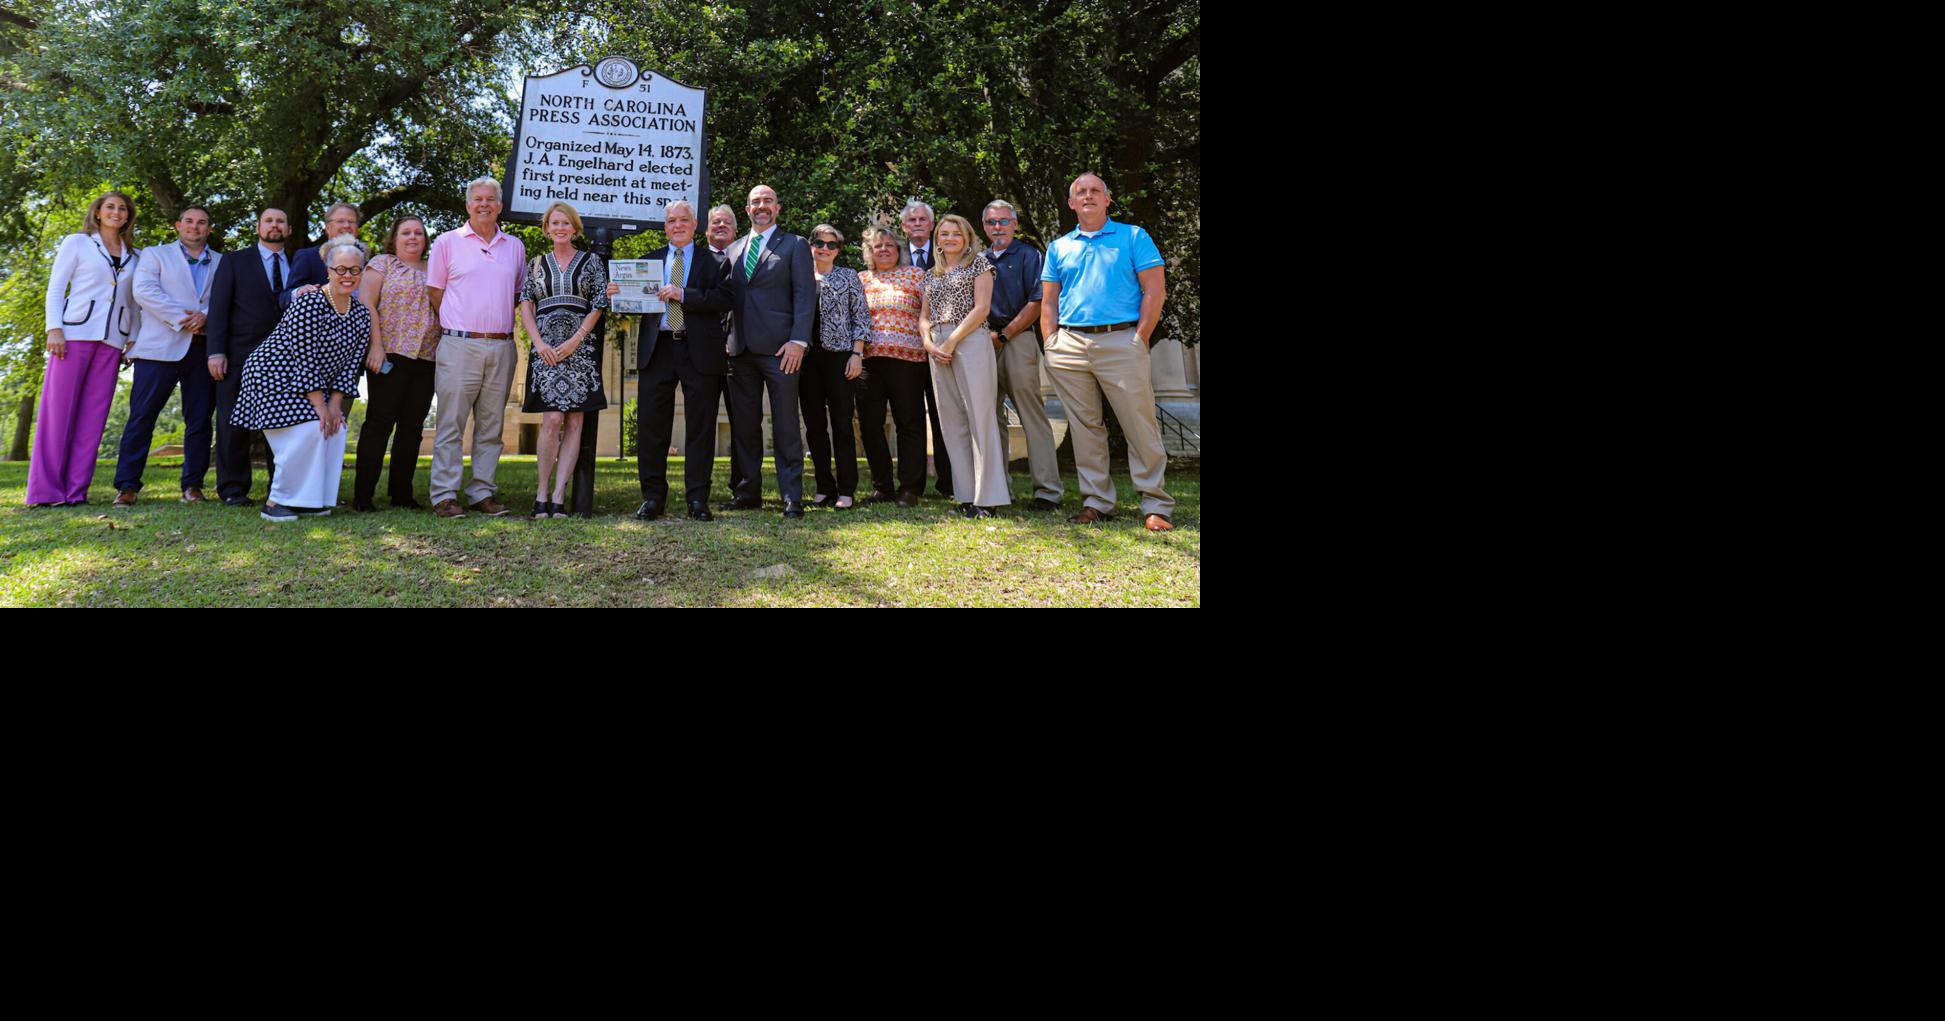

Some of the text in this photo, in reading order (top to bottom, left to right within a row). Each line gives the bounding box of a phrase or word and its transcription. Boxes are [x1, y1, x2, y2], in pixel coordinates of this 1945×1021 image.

[582, 80, 589, 88] F
[640, 84, 650, 93] 51
[540, 94, 686, 117] NORTH CAROLINA
[529, 108, 696, 133] PRESS ASSOCIATION
[526, 135, 601, 153] Organized
[604, 141, 635, 158] May
[660, 145, 694, 160] 1873.
[523, 152, 693, 176] J. A. Engelhard elected
[522, 168, 692, 191] first president at meet-
[520, 185, 542, 200] ing
[546, 185, 578, 200] held
[583, 192, 618, 203] near
[623, 191, 651, 205] this
